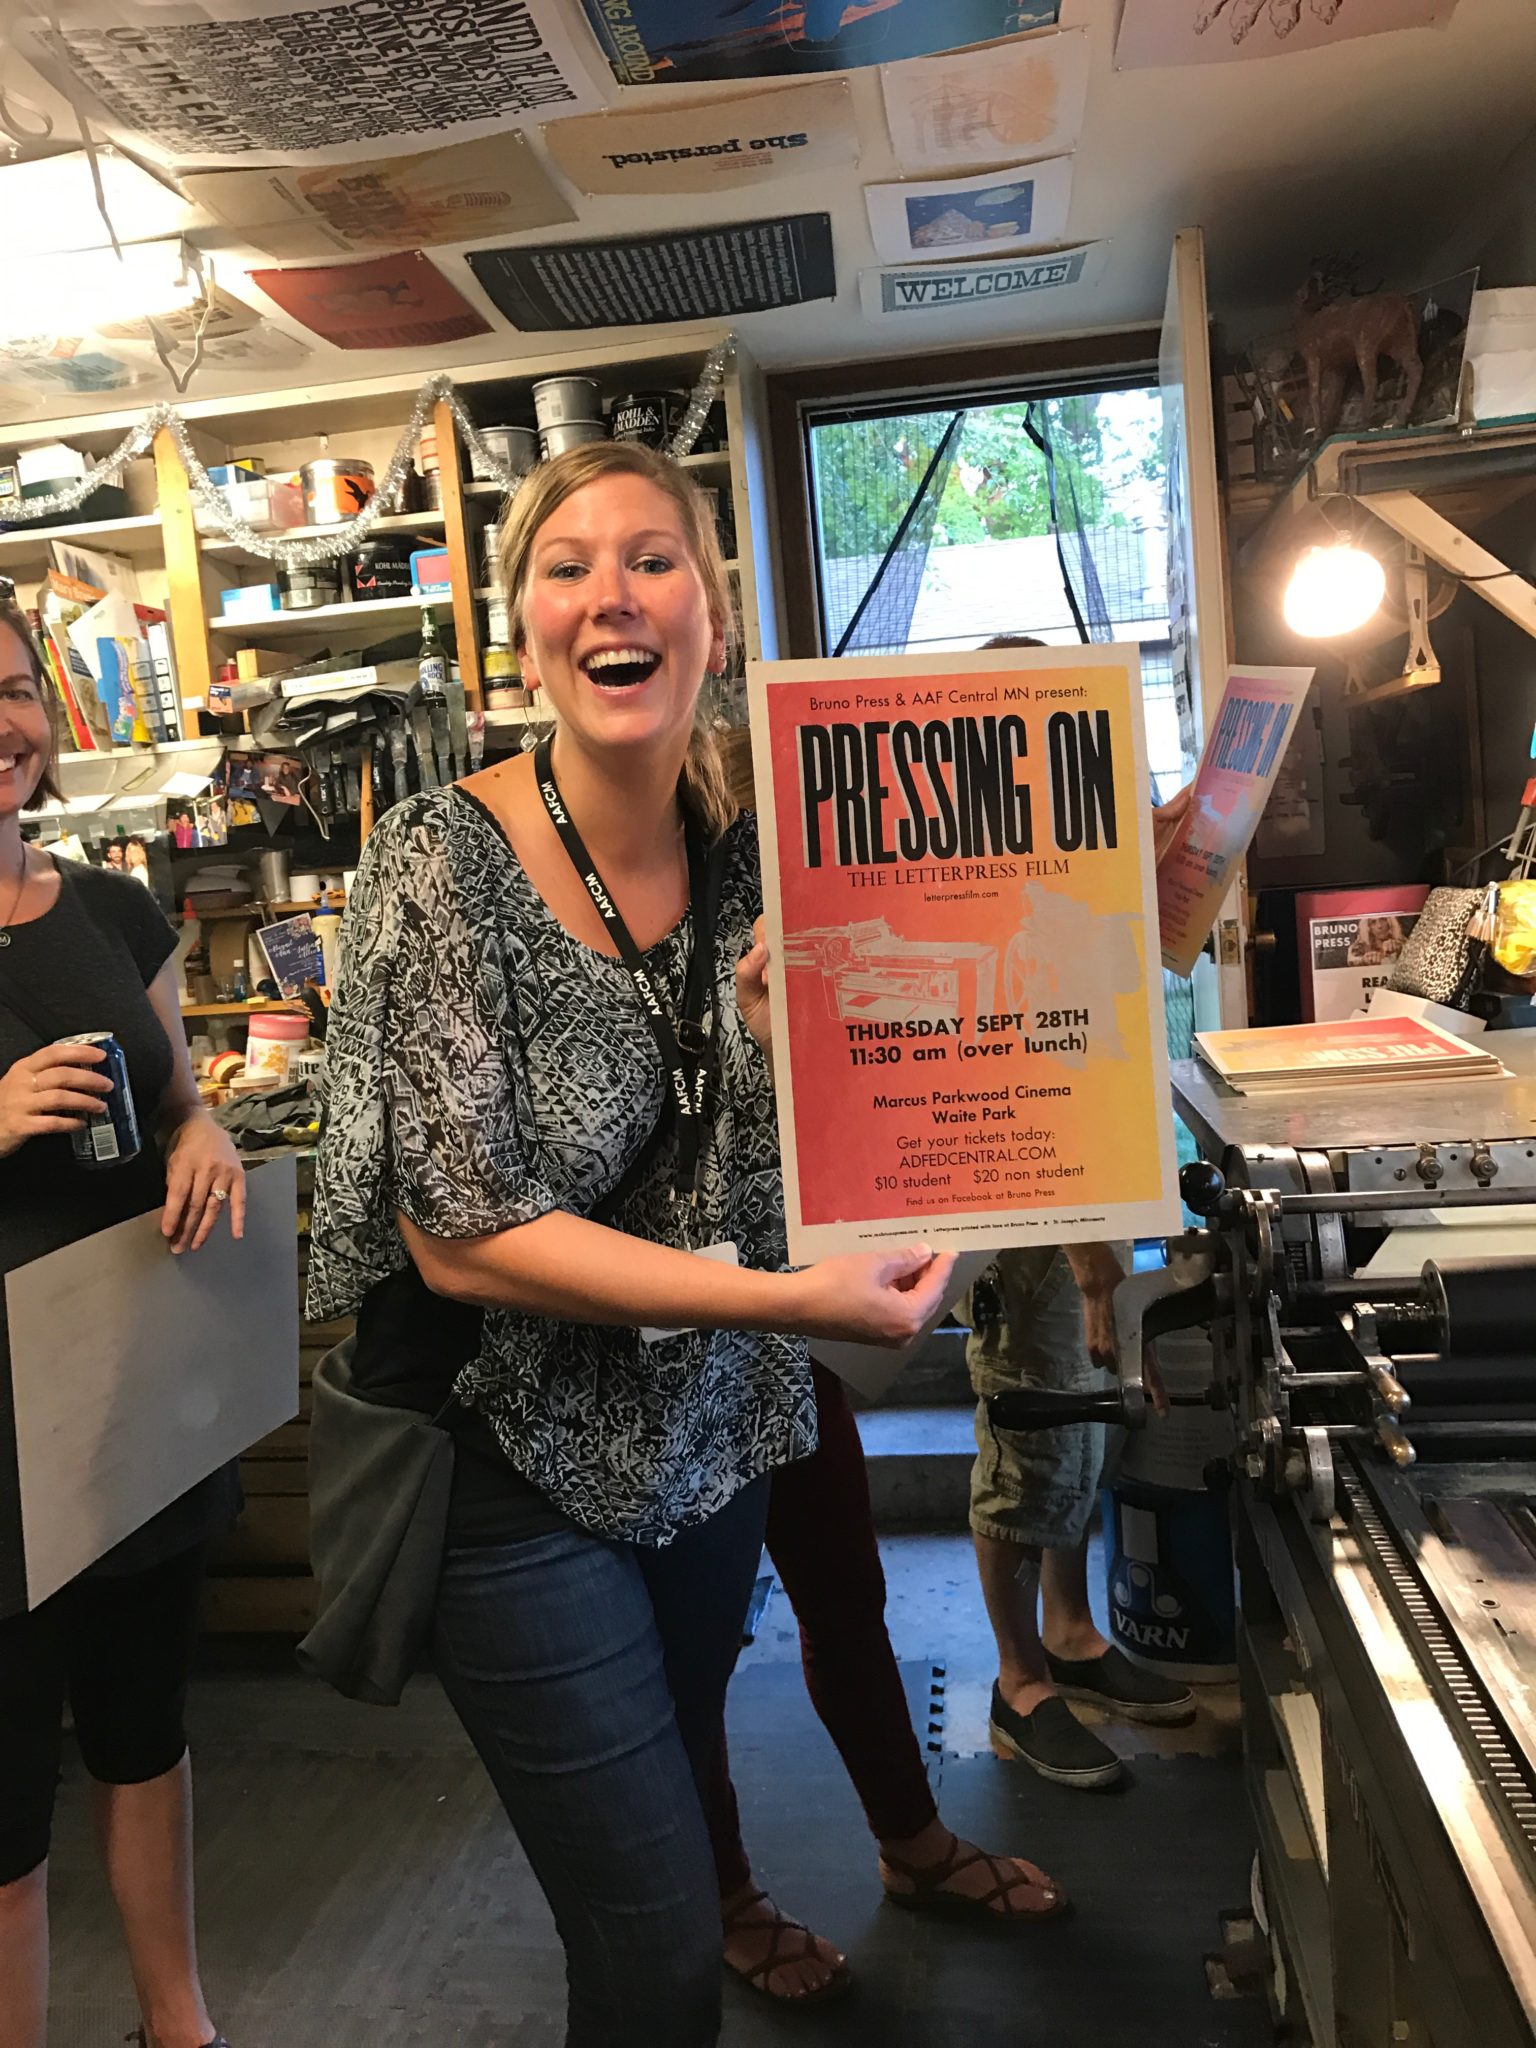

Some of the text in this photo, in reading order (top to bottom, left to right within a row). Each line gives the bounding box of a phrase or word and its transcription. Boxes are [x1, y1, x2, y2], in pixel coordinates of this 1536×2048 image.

[319, 5, 373, 50] POETS
[424, 0, 482, 41] HOSE
[463, 0, 546, 58] ANTED.
[103, 26, 165, 52] OF
[136, 59, 203, 97] THE
[198, 21, 241, 52] HAVE
[229, 56, 268, 83] BEEN
[291, 10, 369, 85] CLERGYMEN
[354, 52, 389, 68] OF
[387, 0, 500, 120] BLES WHOM DEFEAT
[610, 24, 655, 80] AROUND
[240, 18, 275, 40] WHO
[262, 45, 307, 79] SHOULD
[297, 82, 330, 103] HAVE
[316, 104, 347, 124] BEEN
[262, 15, 316, 56] ULOUS
[298, 57, 352, 102] GOSPEL.
[337, 101, 387, 138] ACTORS
[348, 0, 464, 129] CAN NEVER CHANGE.
[500, 51, 559, 80] THE
[351, 85, 383, 101] OF
[368, 70, 407, 94] THE
[363, 100, 388, 109] A
[602, 139, 743, 168] persisted.
[896, 264, 1067, 302] WELCOME
[617, 406, 655, 423] KOHL &
[810, 686, 1088, 711] Bruno Press & AAF Central MN present:
[541, 780, 568, 826] AAFCM
[796, 710, 1117, 869] PRESSING ON
[847, 858, 1070, 888] THE LETTERPRESS FILM
[585, 872, 616, 920] AAFCM
[924, 888, 999, 903] letterpressfilm.com
[1313, 922, 1359, 936] BRUNO
[1314, 937, 1351, 949] PRESS
[633, 969, 662, 1017] AAFCM
[845, 1009, 1089, 1042] THURSDAY SEPT 28TH
[850, 1032, 1088, 1066] 11:30 am (over lunch)
[299, 1060, 320, 1078] ite
[672, 1068, 692, 1115] AAFCM
[873, 1084, 1072, 1109] Marcus Parkwood Cinema
[932, 1105, 1016, 1125] Waite Park
[896, 1128, 1056, 1152] Get your tickets today:
[899, 1146, 1056, 1170] ADFEDCENTRAL.COM
[875, 1163, 1085, 1191] $10 student $20 non student
[906, 1187, 1055, 1207] Find us on Facebook at Bruno Press
[1114, 1607, 1190, 1649] VARN
